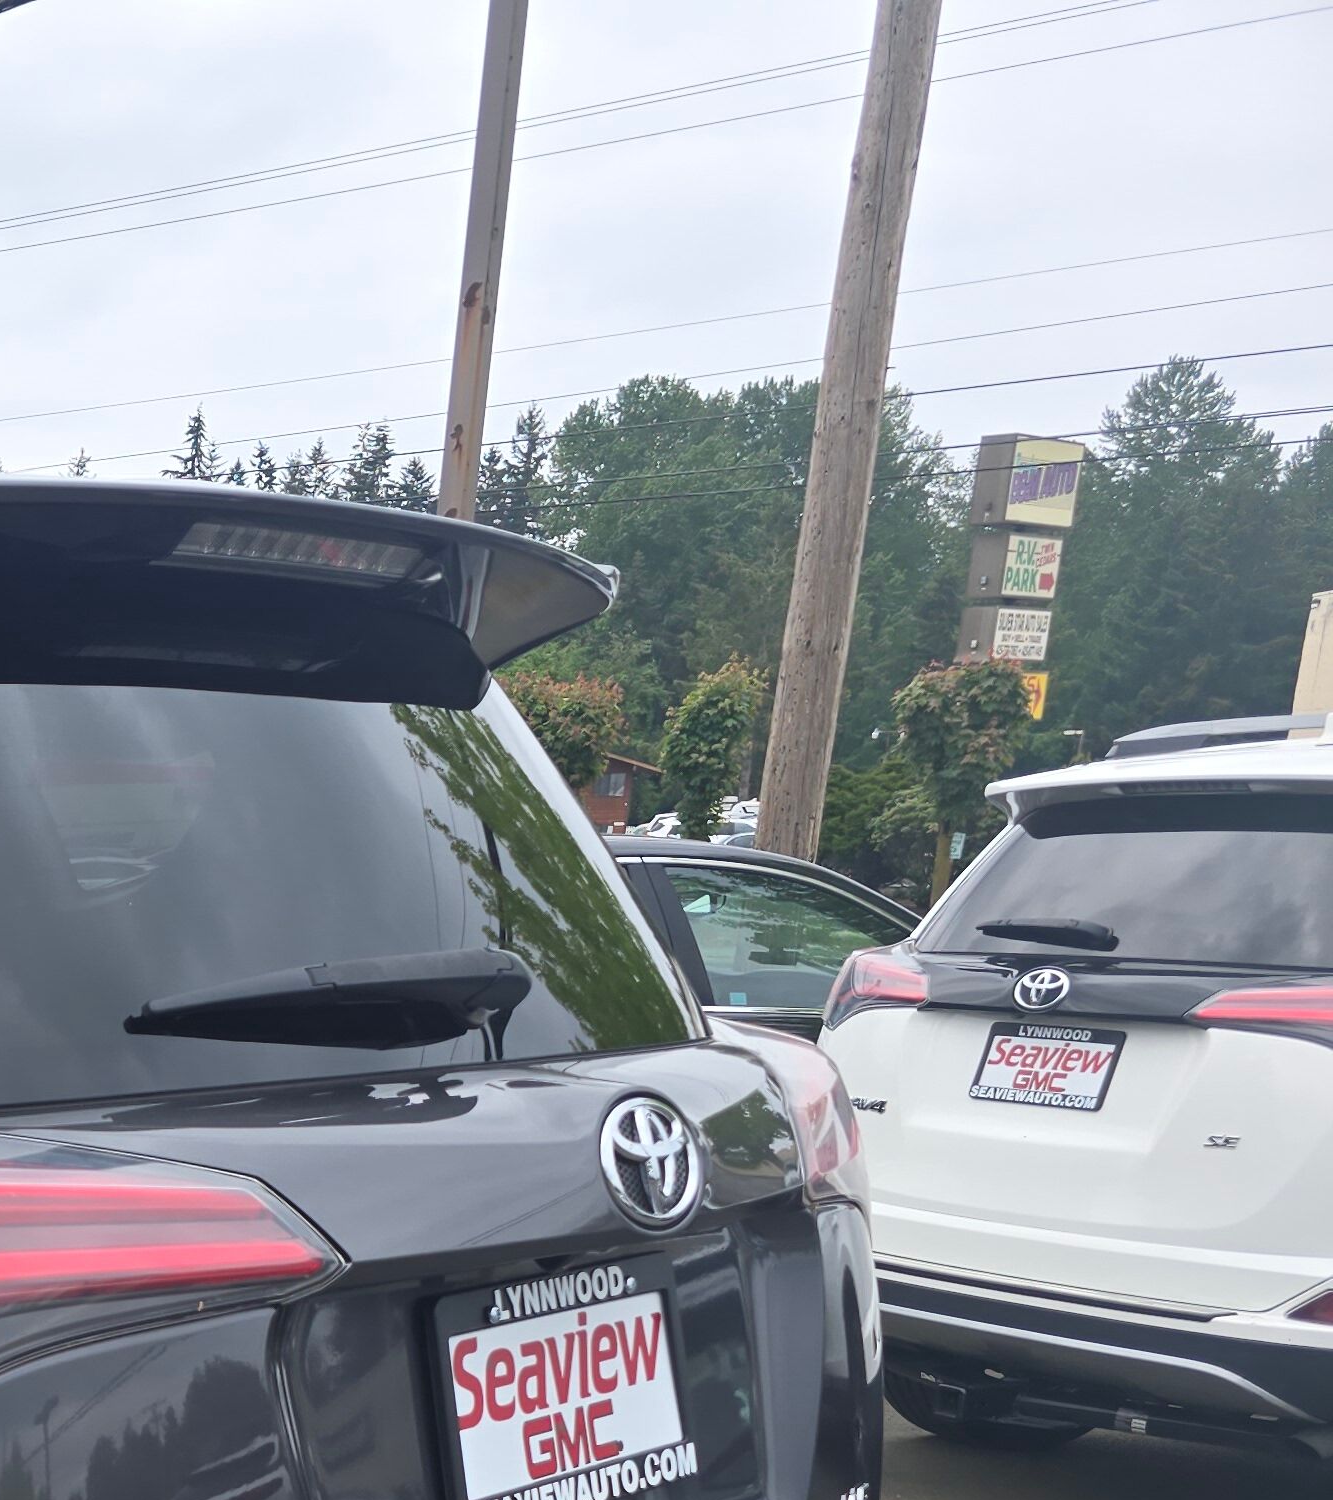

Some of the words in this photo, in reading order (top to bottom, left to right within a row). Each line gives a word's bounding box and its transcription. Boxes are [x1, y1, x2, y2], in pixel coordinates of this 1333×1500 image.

[1004, 566, 1039, 592] PARK
[1018, 1025, 1092, 1041] LYNNWOOD
[987, 1038, 1114, 1074] Seaview
[1013, 1069, 1068, 1092] GMC
[969, 1085, 1099, 1109] SEAVIEWAUTO.COM
[493, 1265, 624, 1322] LYNNWOOD
[452, 1310, 662, 1431] Seaview
[522, 1399, 622, 1480] GMC
